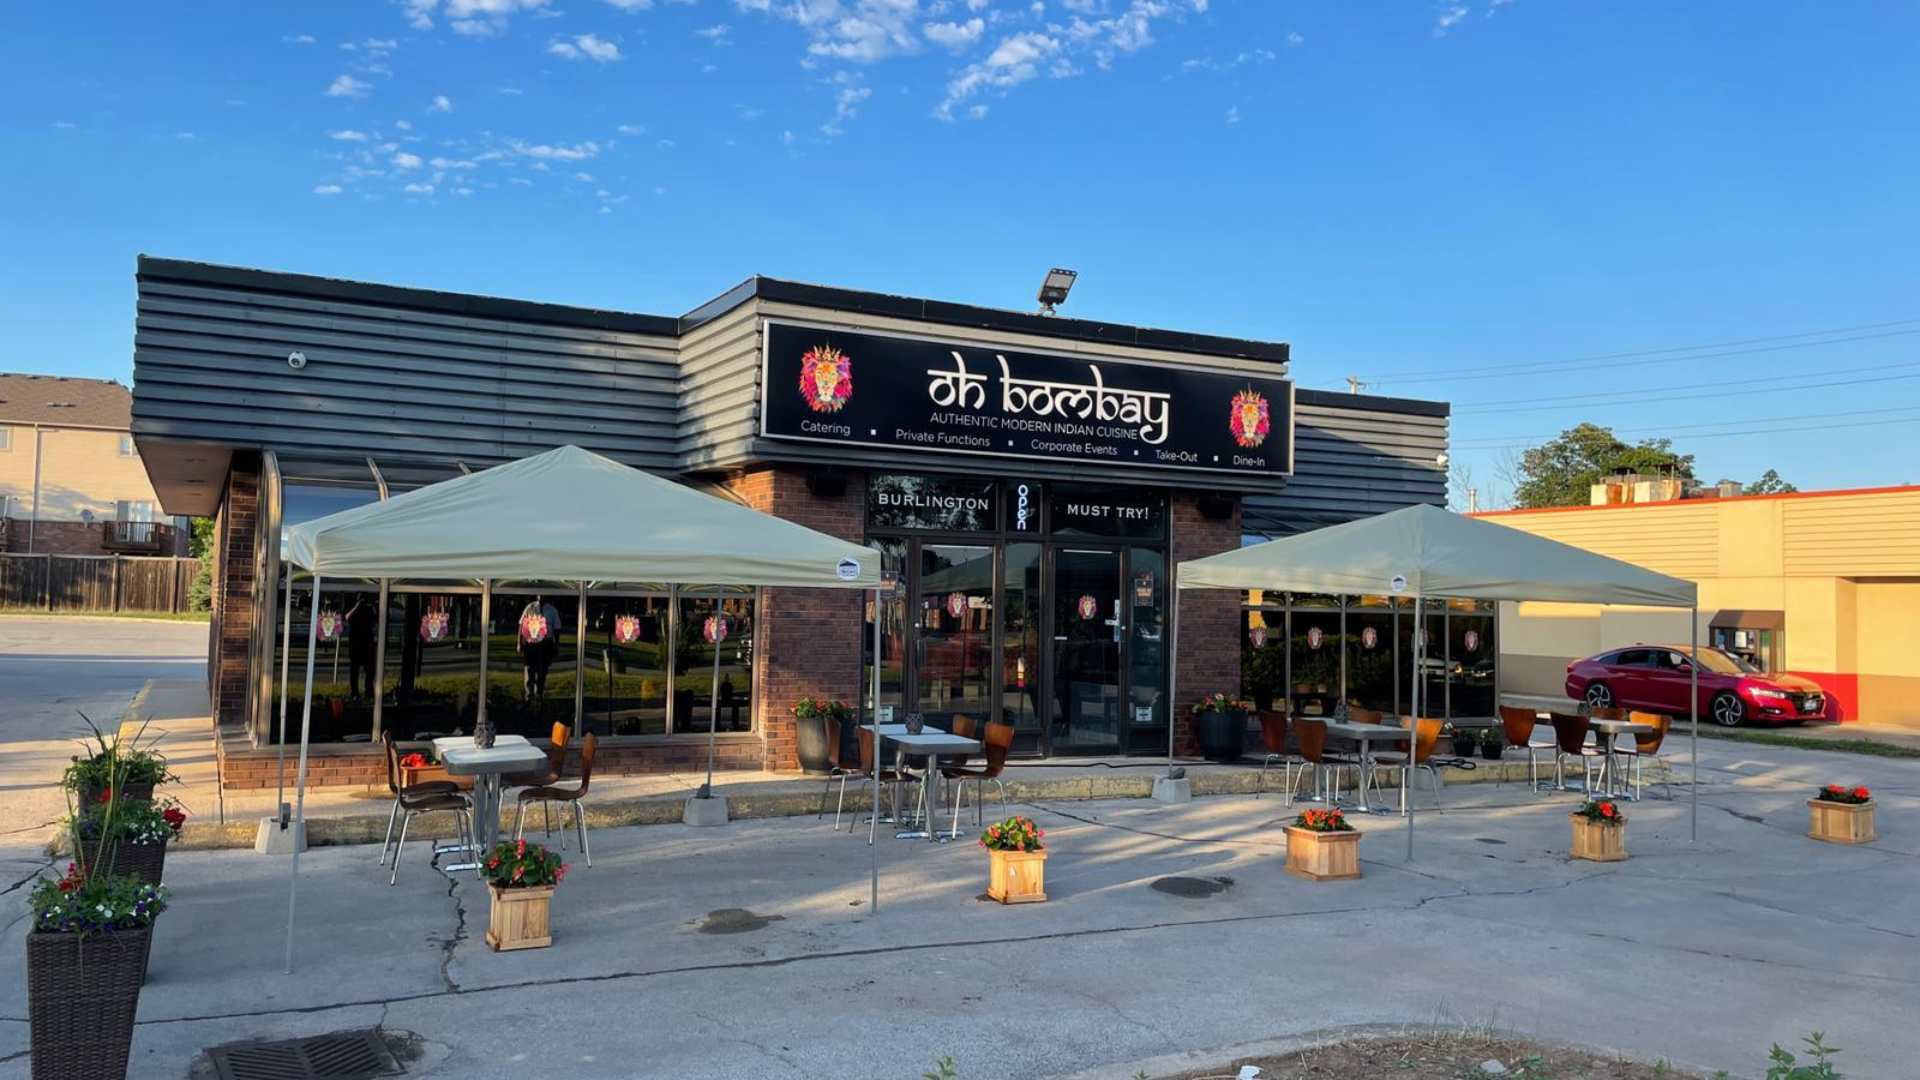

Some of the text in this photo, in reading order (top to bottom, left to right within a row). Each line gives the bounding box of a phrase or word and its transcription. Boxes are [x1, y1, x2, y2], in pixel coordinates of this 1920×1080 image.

[927, 351, 1171, 444] oh bombay
[930, 412, 1138, 440] AUTHENTIC MODERN INDIAN CUISINE
[800, 420, 1266, 467] Catering Private Functions Corporate Events Take-Out Dine-In
[878, 493, 989, 510] BURLINGTON
[1067, 504, 1149, 520] MUST TRY!
